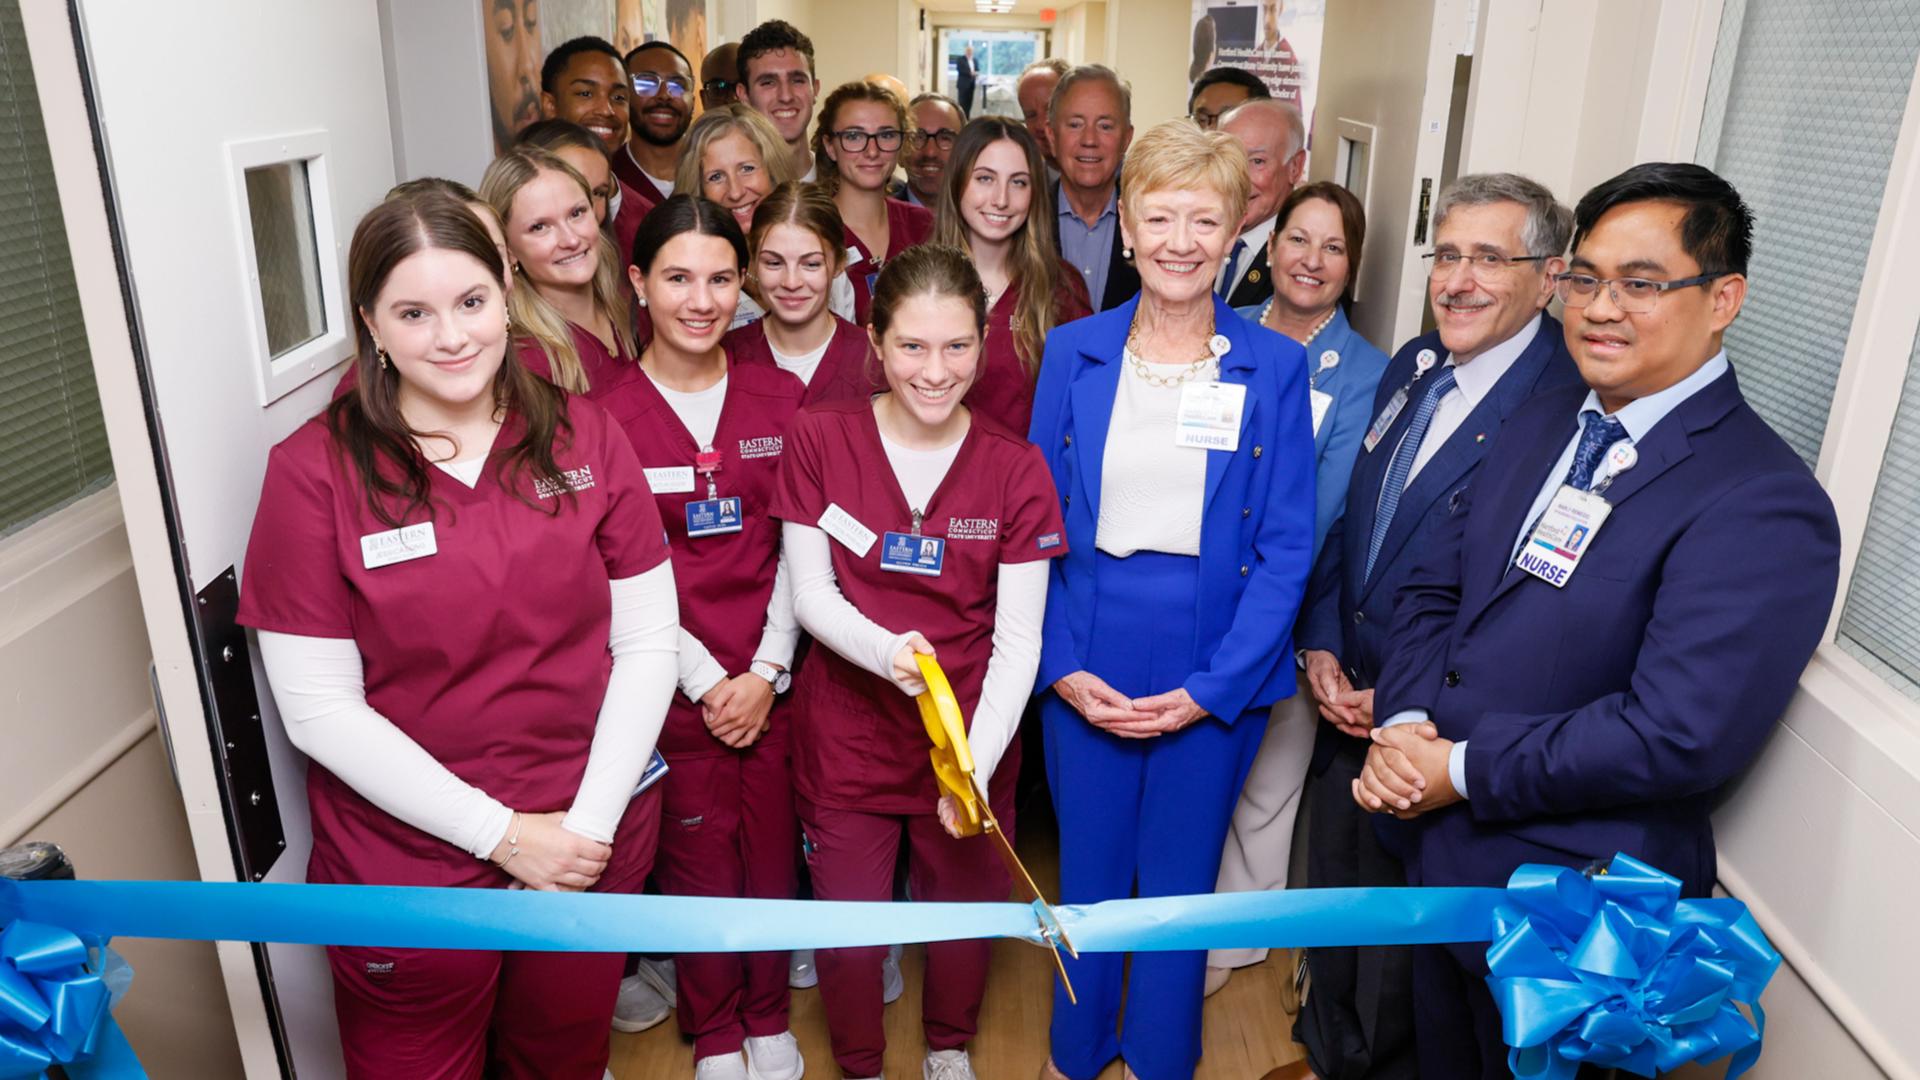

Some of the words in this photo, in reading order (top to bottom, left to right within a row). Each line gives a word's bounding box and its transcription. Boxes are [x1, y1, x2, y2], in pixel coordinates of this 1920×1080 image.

[739, 436, 782, 449] EASTERN
[1185, 433, 1229, 446] NURSE
[740, 444, 783, 454] CONNECTICUT
[949, 517, 998, 529] EASTERN
[1520, 552, 1568, 585] NURSE
